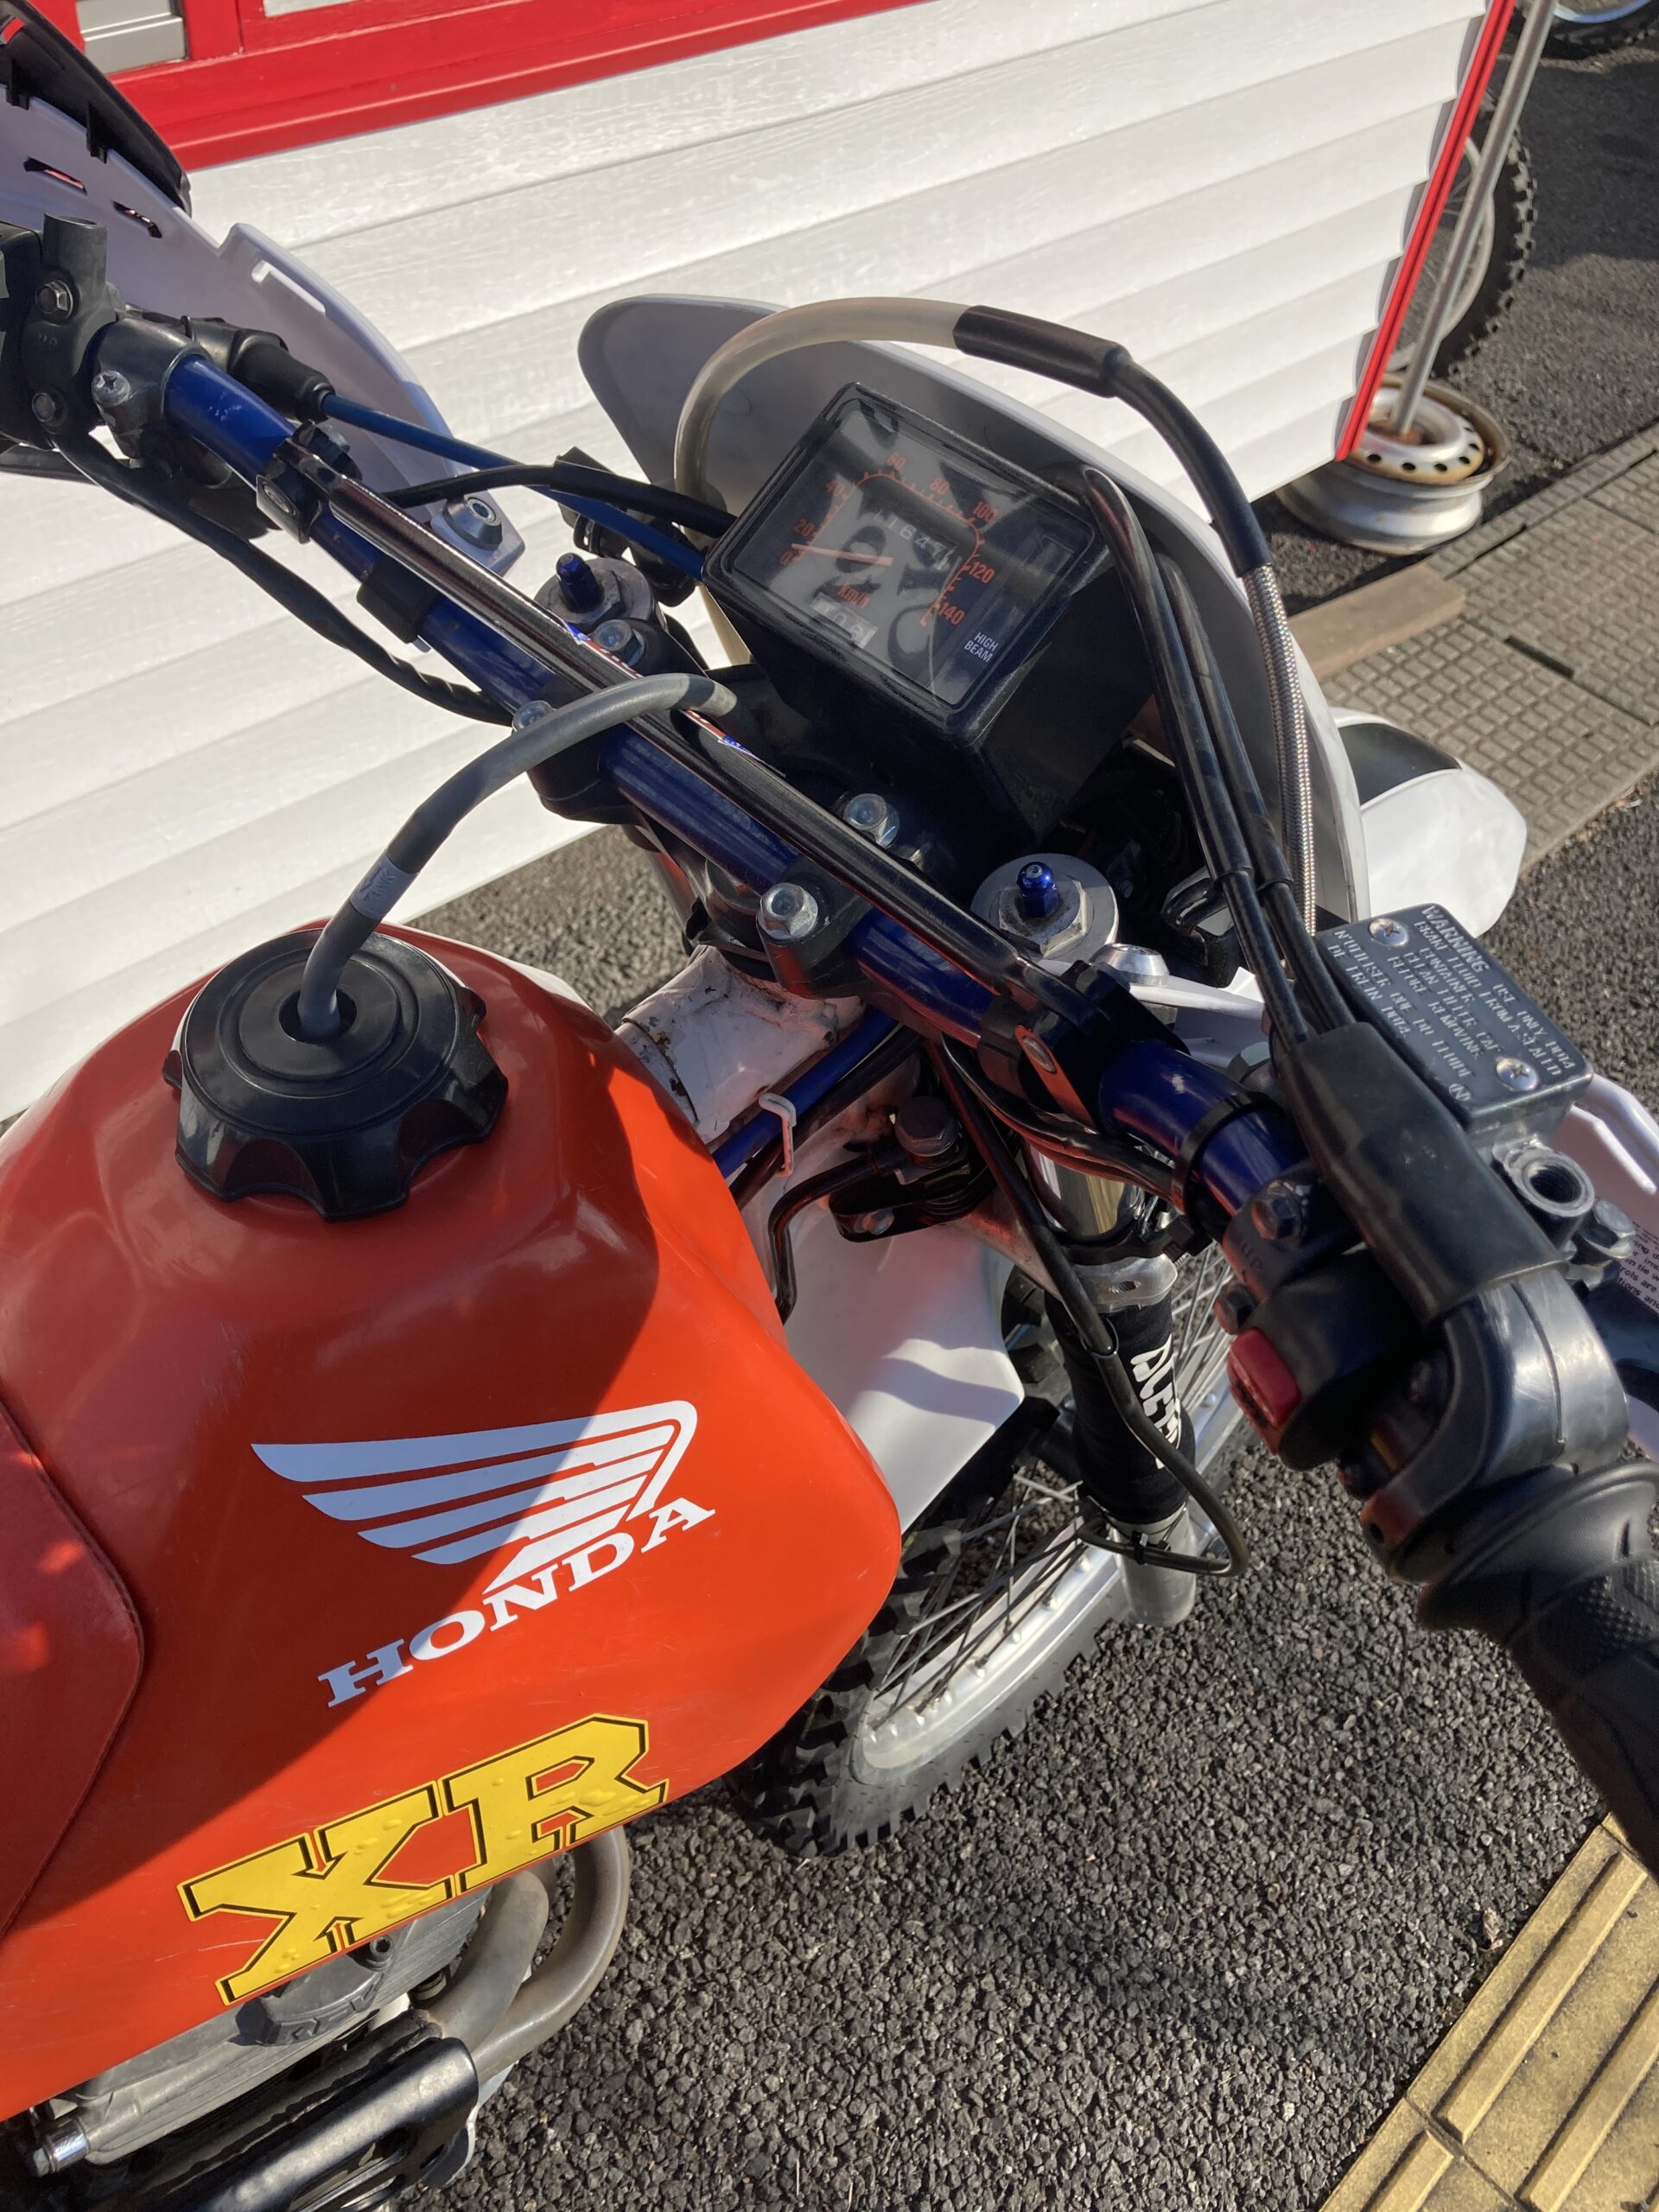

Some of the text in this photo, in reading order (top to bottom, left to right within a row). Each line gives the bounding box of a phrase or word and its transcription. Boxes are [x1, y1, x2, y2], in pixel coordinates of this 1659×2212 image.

[885, 451, 907, 472] 60
[929, 476, 951, 496] 80
[973, 499, 1001, 524] 100
[793, 518, 816, 537] 20
[968, 561, 995, 585] 120
[836, 582, 873, 610] km/h
[938, 602, 965, 626] 140
[963, 639, 995, 664] BEAM
[973, 630, 1000, 652] HIGH
[1345, 965, 1383, 1001] FREIN
[1421, 905, 1491, 974] WARNING
[1516, 1010, 1548, 1036] ONLY
[1403, 951, 1440, 985] CLEAN
[1437, 988, 1478, 1028] FILLER
[1414, 920, 1563, 1077] BRAKE FLUID FROM A SEALED
[316, 1496, 715, 1709] HONDA
[176, 1712, 670, 2007] XR
